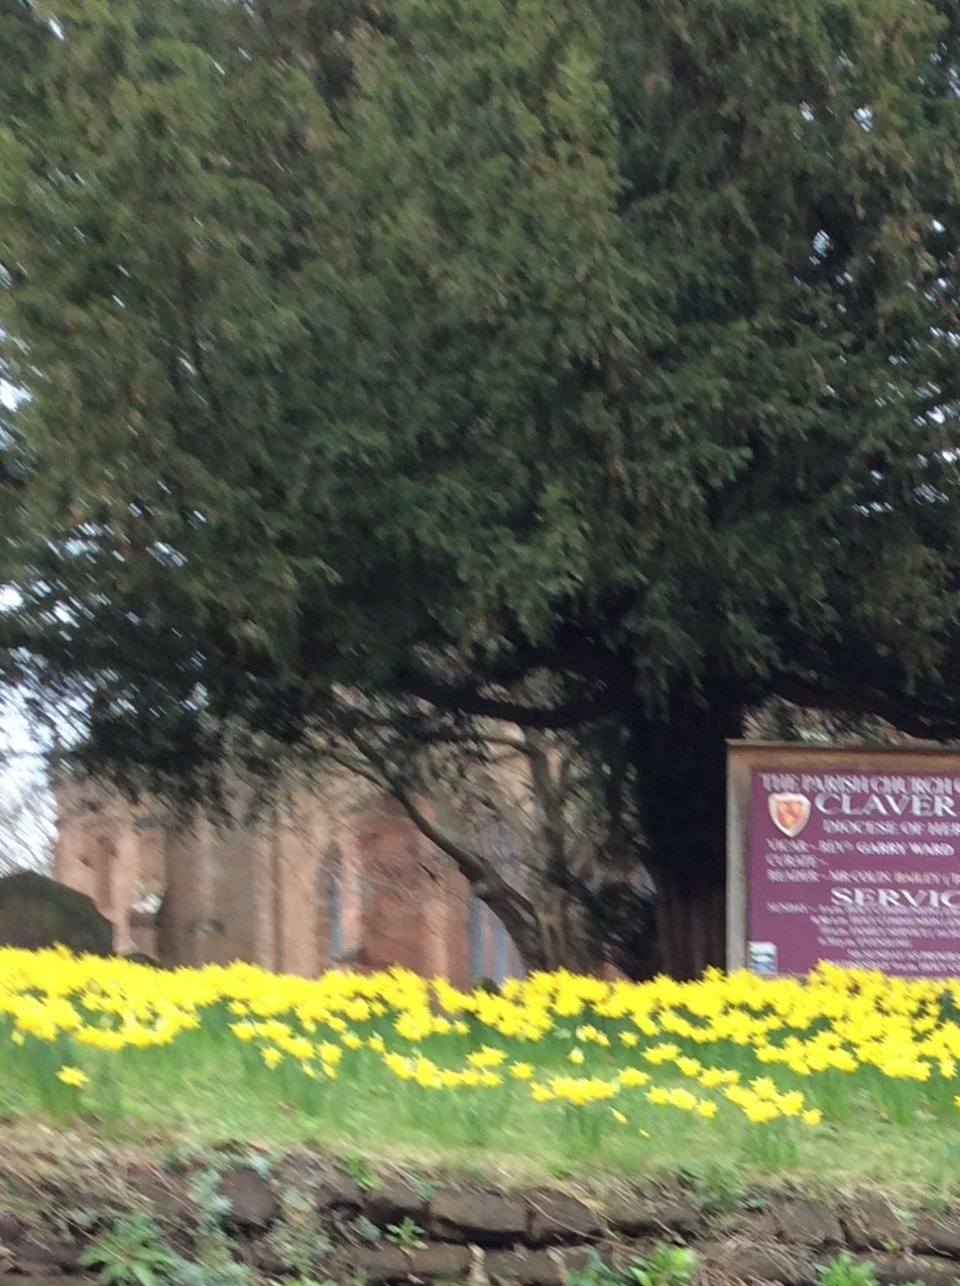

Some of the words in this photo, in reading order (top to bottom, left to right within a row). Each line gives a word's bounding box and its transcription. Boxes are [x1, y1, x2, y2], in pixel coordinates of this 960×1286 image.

[759, 773, 799, 792] THE
[801, 774, 869, 794] PARISH
[870, 776, 952, 795] CHURCH
[822, 819, 899, 835] DIOCESE
[900, 820, 925, 836] OF
[856, 841, 907, 856] GARRY
[909, 842, 955, 857] WARD
